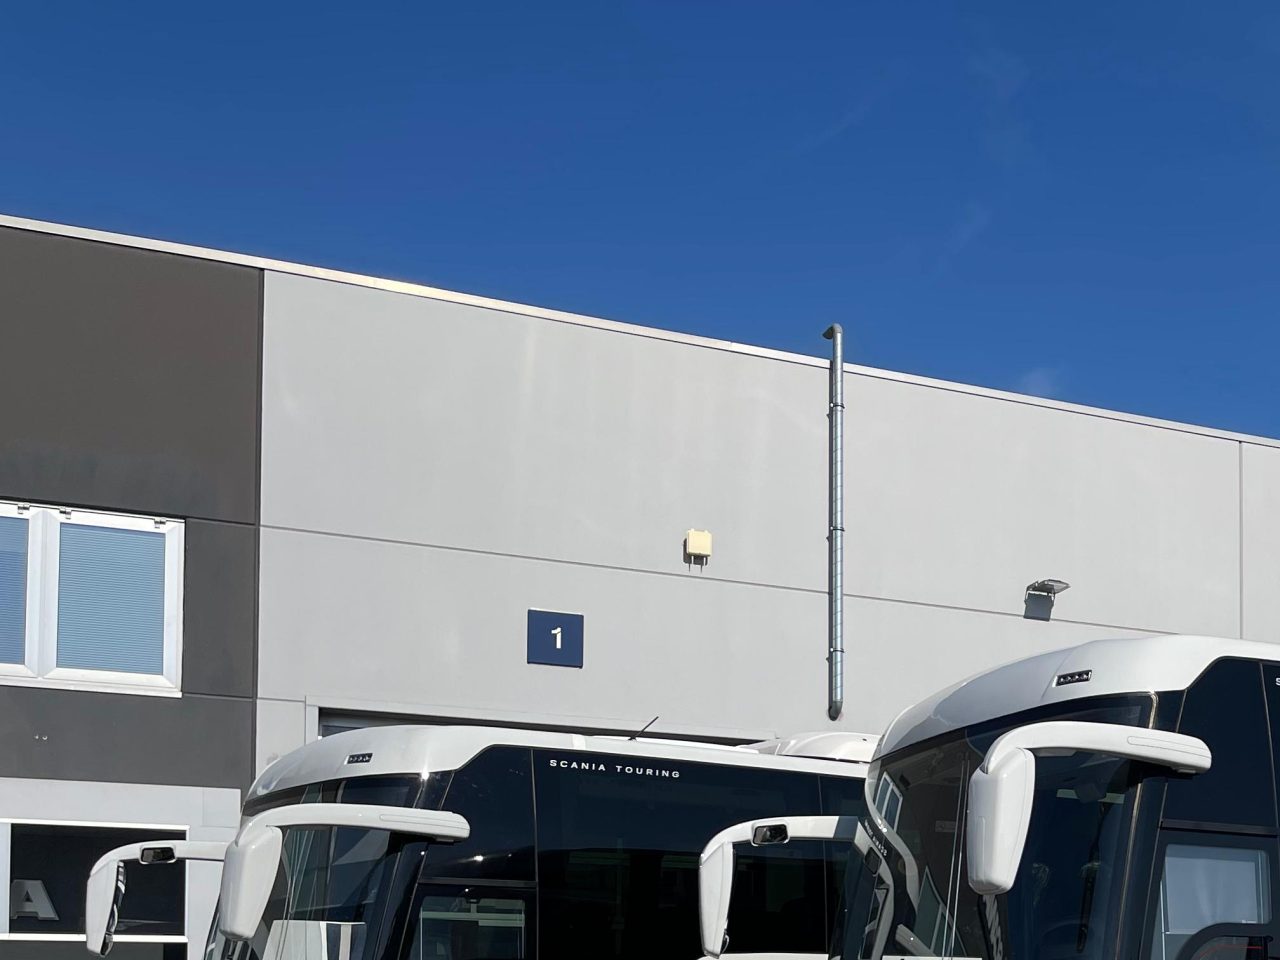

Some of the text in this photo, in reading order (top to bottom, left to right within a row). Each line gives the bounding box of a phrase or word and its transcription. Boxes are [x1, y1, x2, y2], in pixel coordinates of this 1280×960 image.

[551, 627, 562, 649] 1
[549, 759, 680, 778] SCANIA TOURING
